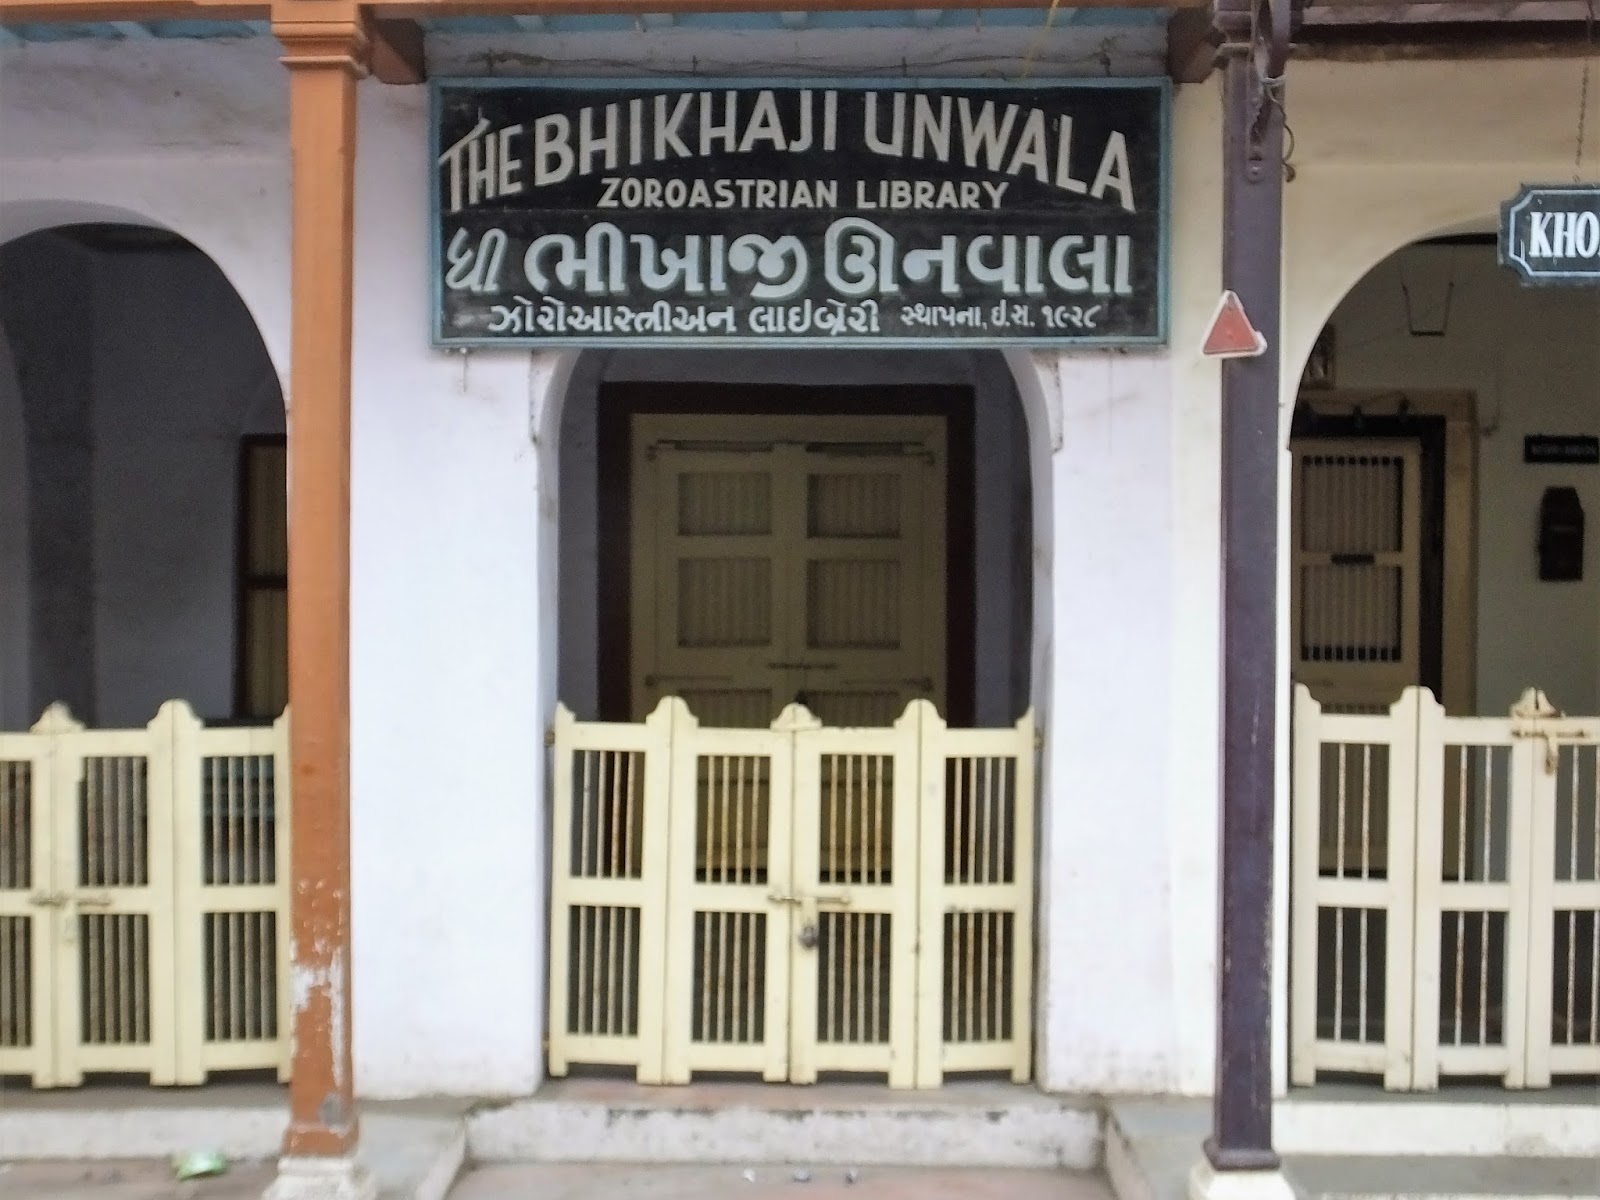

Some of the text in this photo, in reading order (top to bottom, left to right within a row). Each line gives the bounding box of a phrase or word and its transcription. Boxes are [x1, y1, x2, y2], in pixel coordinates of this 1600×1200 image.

[438, 90, 1137, 213] THE BHIKHAJI UNWALA
[597, 177, 1009, 209] ZOROASTRIAN LIBRARY
[445, 217, 1134, 299] ધી ભીખાજી ઊનવાલા
[1529, 210, 1600, 258] KHO
[748, 298, 880, 335] લાઇબ્રેરી
[1041, 305, 1102, 328] ૧૯૨૮
